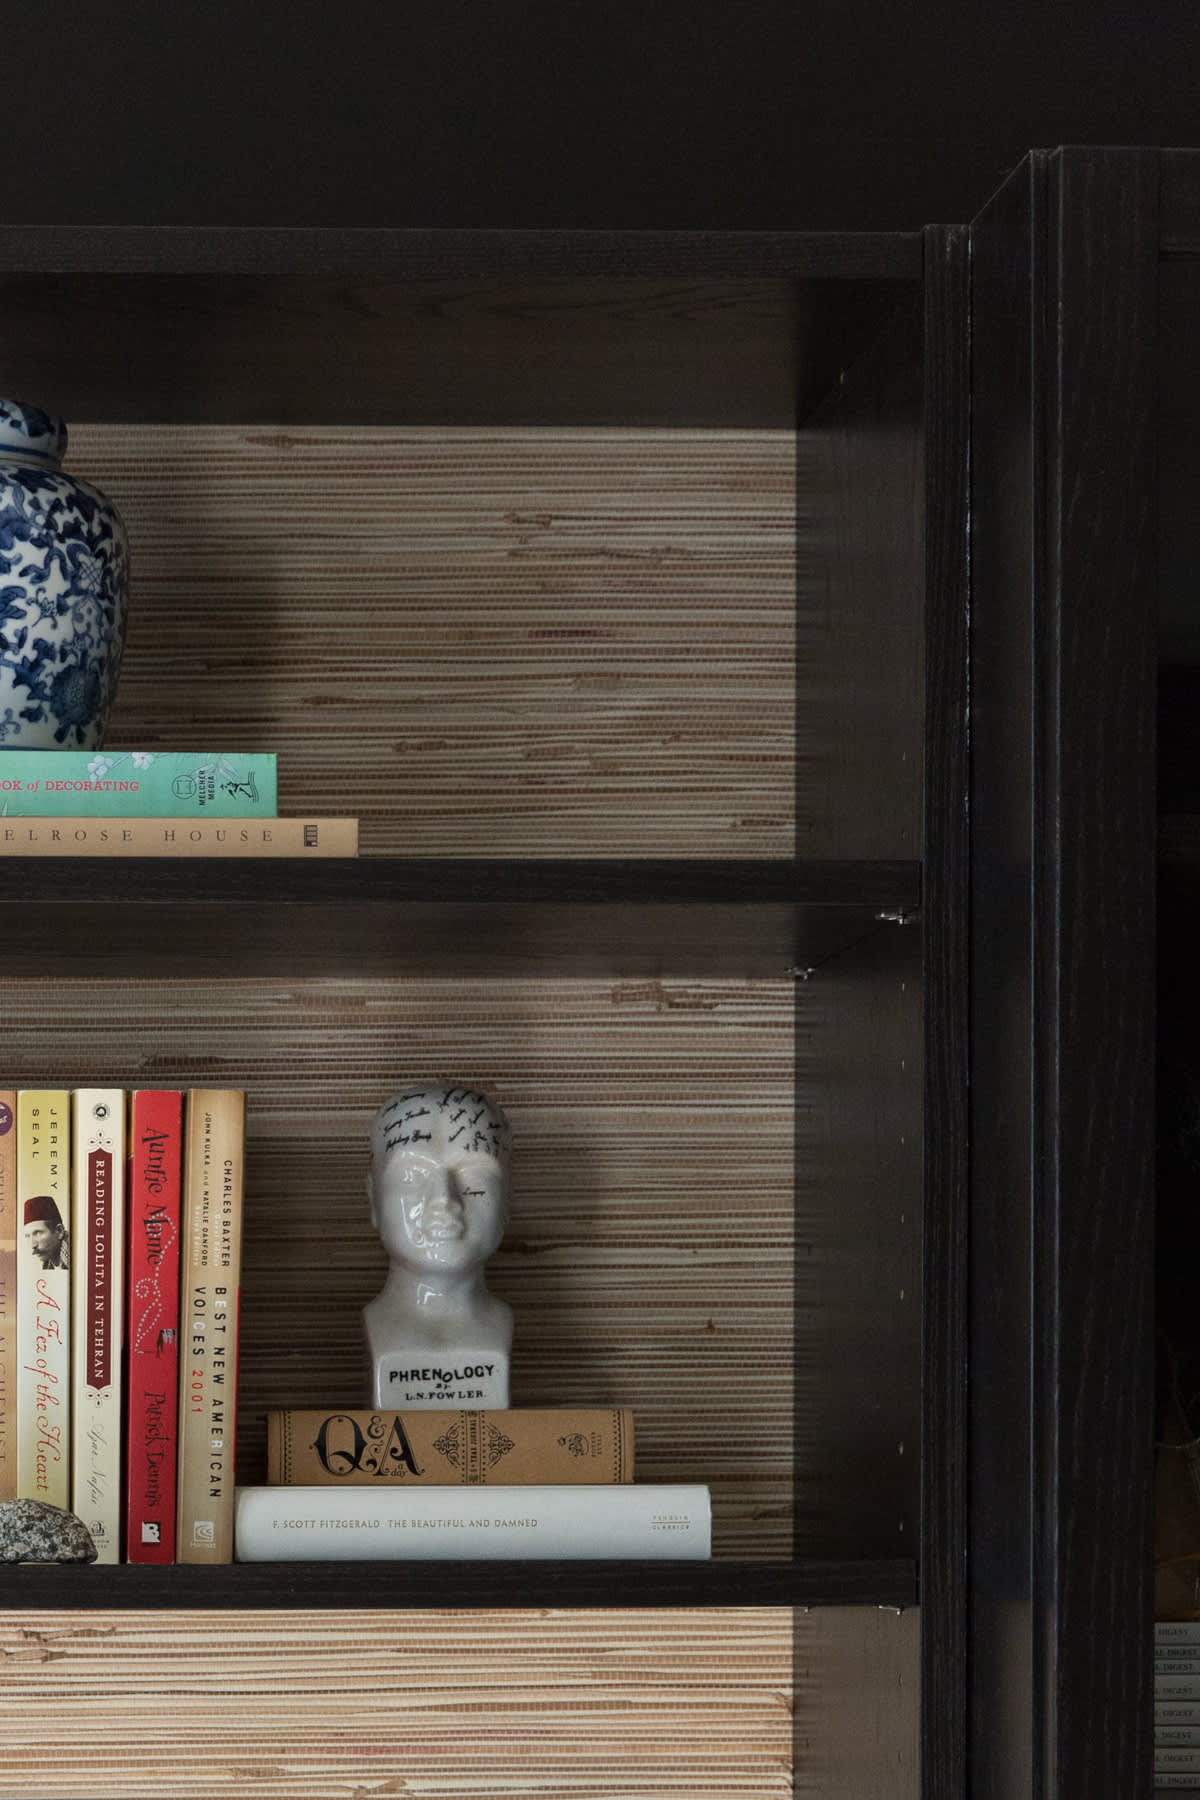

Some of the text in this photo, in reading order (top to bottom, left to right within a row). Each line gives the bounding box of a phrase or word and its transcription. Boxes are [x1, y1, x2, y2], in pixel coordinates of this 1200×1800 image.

[26, 779, 40, 792] of
[45, 781, 140, 793] DECORATING
[164, 829, 273, 842] HOUSE
[50, 1109, 58, 1190] JEREMY
[94, 1160, 105, 1378] READING LOLITA IN TEHRAN
[191, 1286, 206, 1413] VOICES 2001
[389, 1364, 495, 1383] PHRENOLOGY
[209, 1287, 227, 1498] BEST NEW AMERICAN
[283, 1520, 316, 1528] SCOTT
[319, 1519, 380, 1528] FITZGERALD
[388, 1519, 407, 1528] THE
[411, 1519, 466, 1528] BEAUTIFUL
[468, 1519, 491, 1528] AND
[494, 1518, 538, 1528] DAMNED
